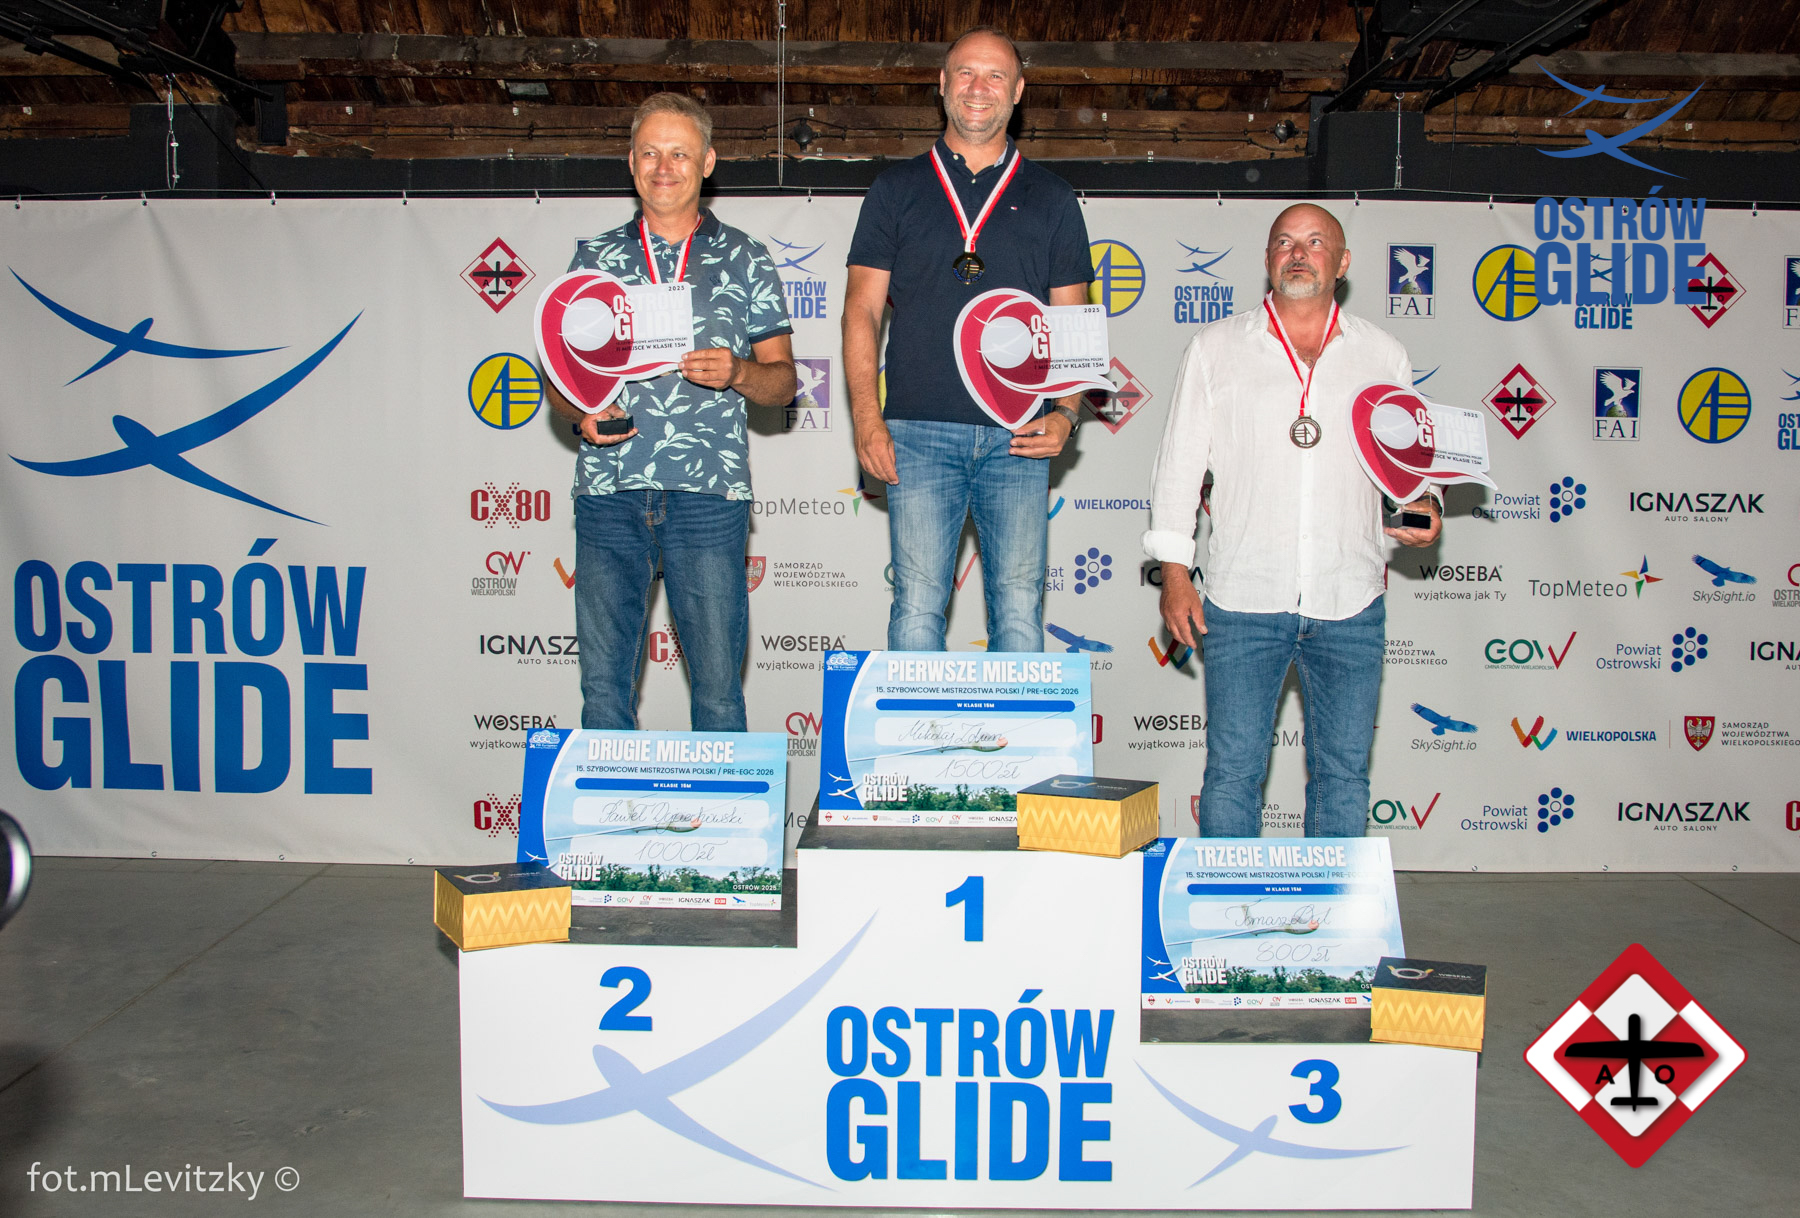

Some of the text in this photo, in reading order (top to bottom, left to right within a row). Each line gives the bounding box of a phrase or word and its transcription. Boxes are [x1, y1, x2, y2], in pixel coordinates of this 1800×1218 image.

[782, 277, 827, 296] STRÓW
[1174, 282, 1234, 302] OSTRÓW
[785, 297, 827, 319] LIDE
[1174, 301, 1234, 324] GLIDE
[1388, 296, 1433, 317] FAI
[614, 310, 688, 341] GLIDE
[1574, 308, 1633, 330] GLIDE
[1032, 330, 1104, 360] GLIDE
[784, 410, 831, 430] FAI
[1595, 419, 1639, 440] FAI
[1417, 424, 1482, 455] GLIDE
[471, 482, 551, 529] CX80
[1074, 499, 1151, 510] WIELKOPOLS
[1494, 493, 1541, 506] Powiat
[1629, 492, 1765, 513] IGNASZAK
[751, 498, 846, 518] opMeteo
[1471, 507, 1541, 520] Ostrowski
[773, 562, 824, 571] SAMORZĄD
[1047, 566, 1064, 578] iat
[1419, 565, 1503, 582] WOSEBA
[773, 570, 846, 579] WOJEWÓDZTWA
[472, 575, 518, 589] OSTRÓW
[773, 580, 859, 588] WIELKOPOLSKIEGO
[471, 588, 516, 597] WIELKOPOLSKI
[1414, 590, 1507, 601] wyjątkowa jak Ty
[1528, 579, 1628, 600] TopMeteo
[1773, 588, 1800, 601] OSTR
[14, 538, 367, 656] OSTRÓW
[1692, 590, 1757, 604] SkySight.io
[480, 634, 579, 656] IGNASZ
[761, 635, 846, 652] WOSEBA
[1383, 639, 1414, 648] ORZĄD
[1616, 643, 1662, 655] Powiat
[1383, 647, 1436, 657] EWÓDZTWA
[756, 660, 815, 670] wyjątkowa
[1382, 657, 1448, 666] LKOPOLSKIEGO
[1596, 657, 1662, 670] Ostrowski
[887, 659, 977, 683] PIERWSZE
[982, 660, 1063, 684] MIEJSCE
[994, 687, 1020, 695] POLSKI
[1021, 687, 1025, 696] /
[14, 655, 373, 796] GLIDE
[473, 714, 558, 731] WOSEBA
[1721, 722, 1770, 730] SAMORZĄD
[1566, 730, 1657, 742] WIELKOPOLSKA
[1721, 729, 1790, 738] WOJEWÓDZTWA
[470, 739, 526, 750] wyjątkowa
[787, 737, 818, 750] TRÓW
[1128, 740, 1186, 750] wyjątkowa
[1410, 739, 1477, 752] SkySight.io
[587, 738, 651, 762] DRUGIE
[655, 740, 735, 764] MIEJSCE
[787, 749, 816, 757] KOPOLSKI
[576, 764, 775, 776] 15. SZYBOWCOWE MISTRZOSTWA POLSKI / PRE-EGC 2026
[863, 772, 909, 786] OSTRÓW
[864, 785, 909, 802] GLIDE
[1263, 810, 1302, 820] ÓDZTWA
[1482, 804, 1528, 817] Powiat
[1617, 801, 1751, 822] IGNASZAK
[1460, 818, 1528, 831] Ostrowski
[558, 851, 603, 865] OSTRÓW
[1194, 845, 1347, 868] TRZECIE MIEJSCE
[559, 864, 602, 881] GLIDE
[1196, 871, 1249, 879] SZYBOWCOWE
[1249, 871, 1301, 879] MISTRZOSTWA
[1301, 871, 1326, 879] POLSKI
[945, 875, 984, 942] 1
[1182, 955, 1228, 969] OSTRÓW
[1184, 968, 1228, 985] GLIDE
[599, 966, 653, 1031] 2
[826, 988, 1115, 1078] OSTRÓW
[1288, 1058, 1342, 1124] 3
[826, 1077, 1114, 1182] GLIDE
